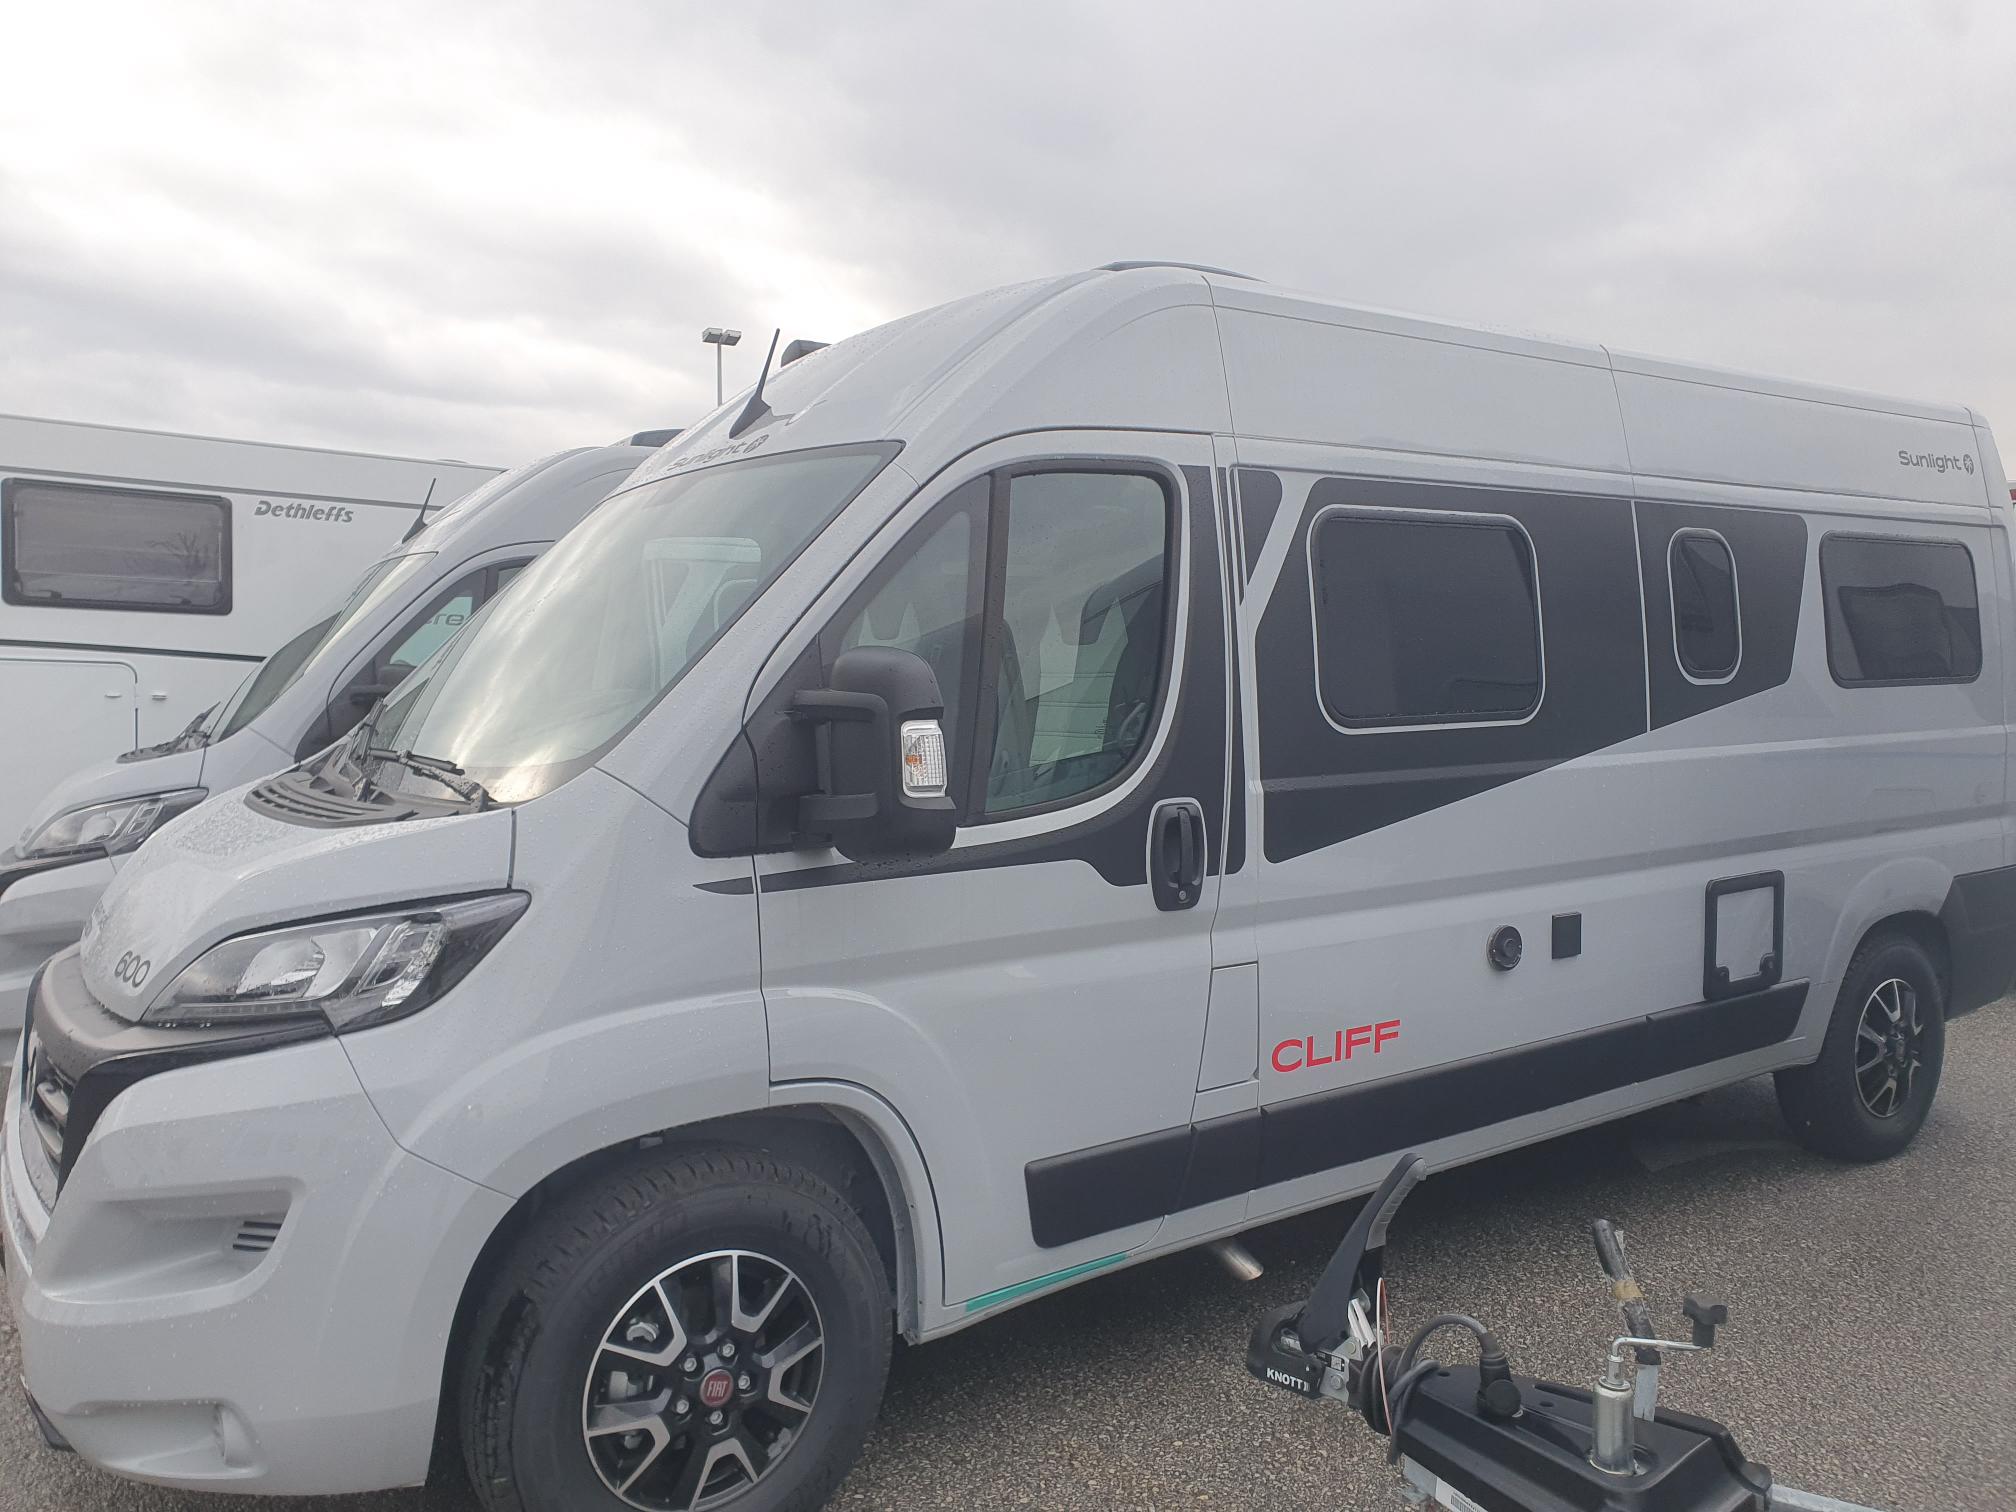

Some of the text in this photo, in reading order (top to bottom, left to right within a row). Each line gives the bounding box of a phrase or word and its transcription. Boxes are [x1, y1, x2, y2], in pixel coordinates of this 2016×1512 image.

[1898, 450, 1962, 473] Sunlight
[254, 500, 354, 523] Dethleffs
[114, 949, 151, 988] 600
[1271, 1019, 1401, 1073] CLIFF
[706, 1379, 729, 1398] FIAT
[1266, 1367, 1303, 1390] KNOTT
